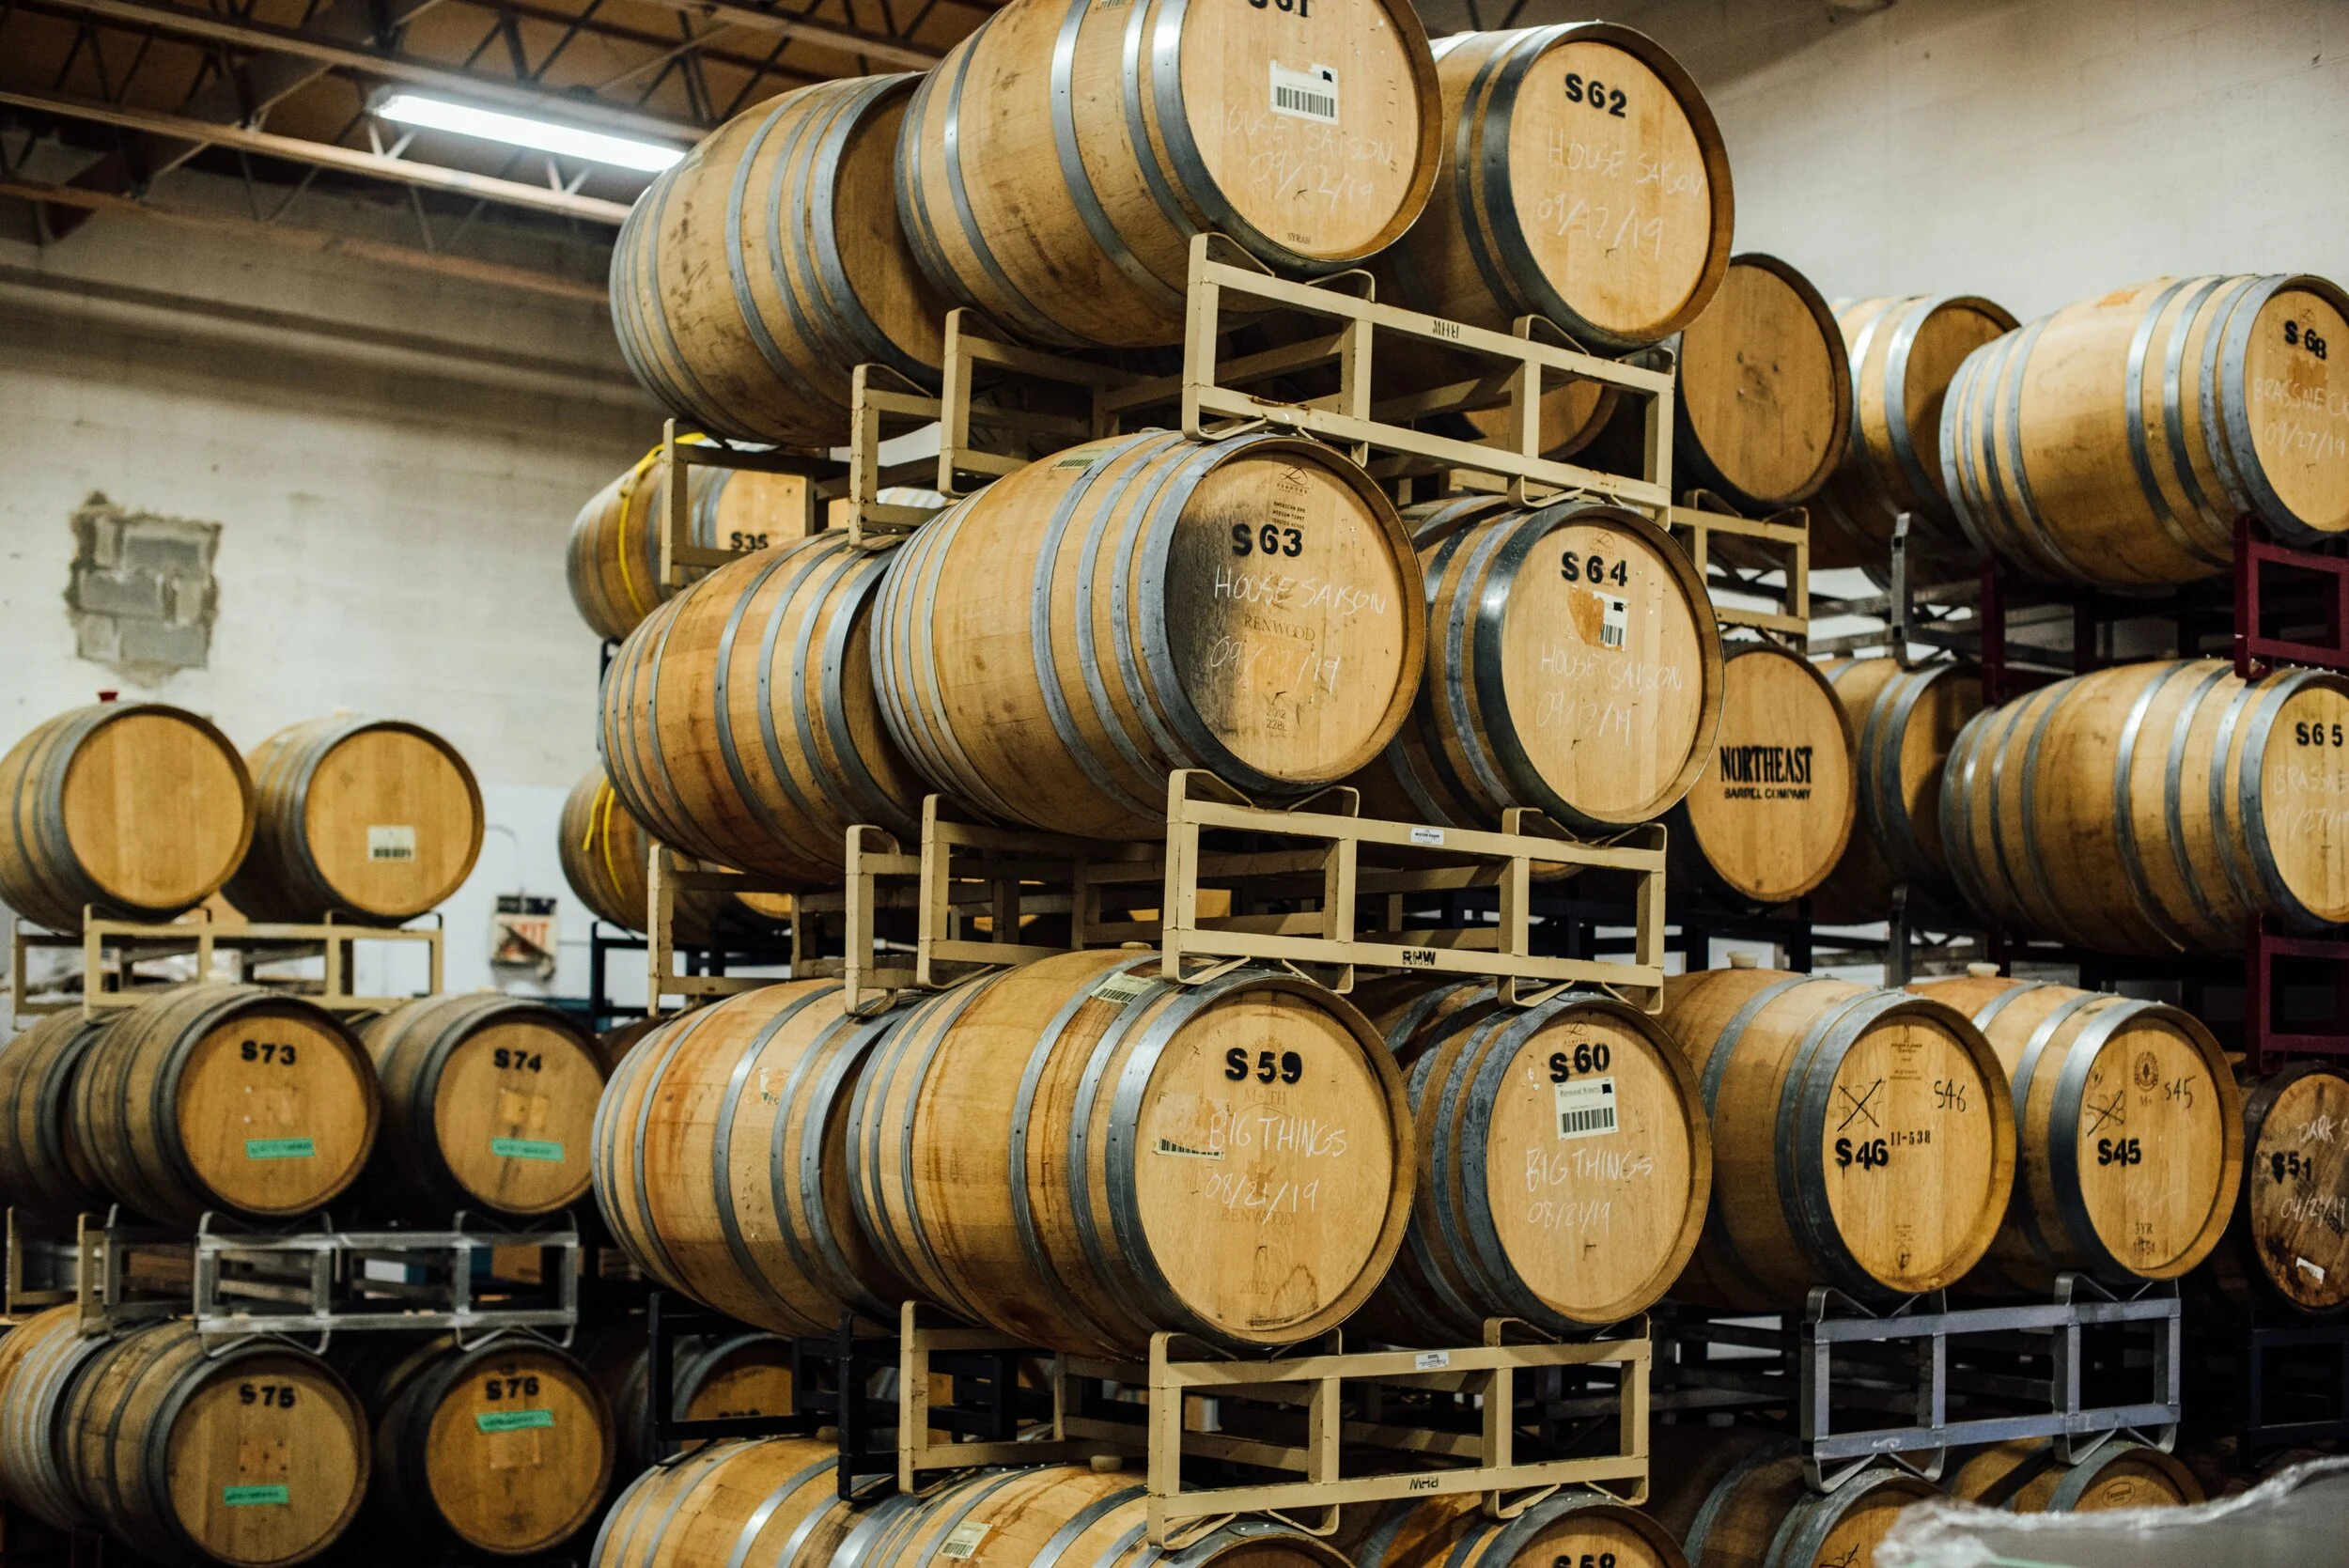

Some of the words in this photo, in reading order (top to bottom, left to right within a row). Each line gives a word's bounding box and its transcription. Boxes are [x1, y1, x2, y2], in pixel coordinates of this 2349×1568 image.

[1564, 72, 1627, 118] S62
[1287, 232, 1311, 245] SYRAH
[1232, 522, 1303, 557] S63
[1215, 564, 1297, 605] HOUSE
[1561, 551, 1627, 587] S64
[1244, 613, 1315, 642] RENWOOD
[2295, 722, 2343, 747] S65
[1719, 745, 1813, 784] NORTHEAST
[1724, 788, 1762, 800] BARREL
[1765, 787, 1812, 800] COMPANY
[241, 1039, 296, 1065] S73
[493, 1047, 542, 1073] S74
[1224, 1047, 1303, 1085] S59
[1548, 1042, 1610, 1084] S60
[1934, 1079, 1966, 1112] S46
[2165, 1076, 2197, 1109] S45
[1209, 1110, 1252, 1151] BIG
[1258, 1115, 1347, 1158] THINGS
[1890, 1130, 1931, 1146] 11-538
[1835, 1138, 1890, 1172] S46
[2097, 1138, 2142, 1167] S45
[1526, 1148, 1568, 1192] BIG
[1239, 1280, 1268, 1295] 2012
[240, 1382, 296, 1409] S75
